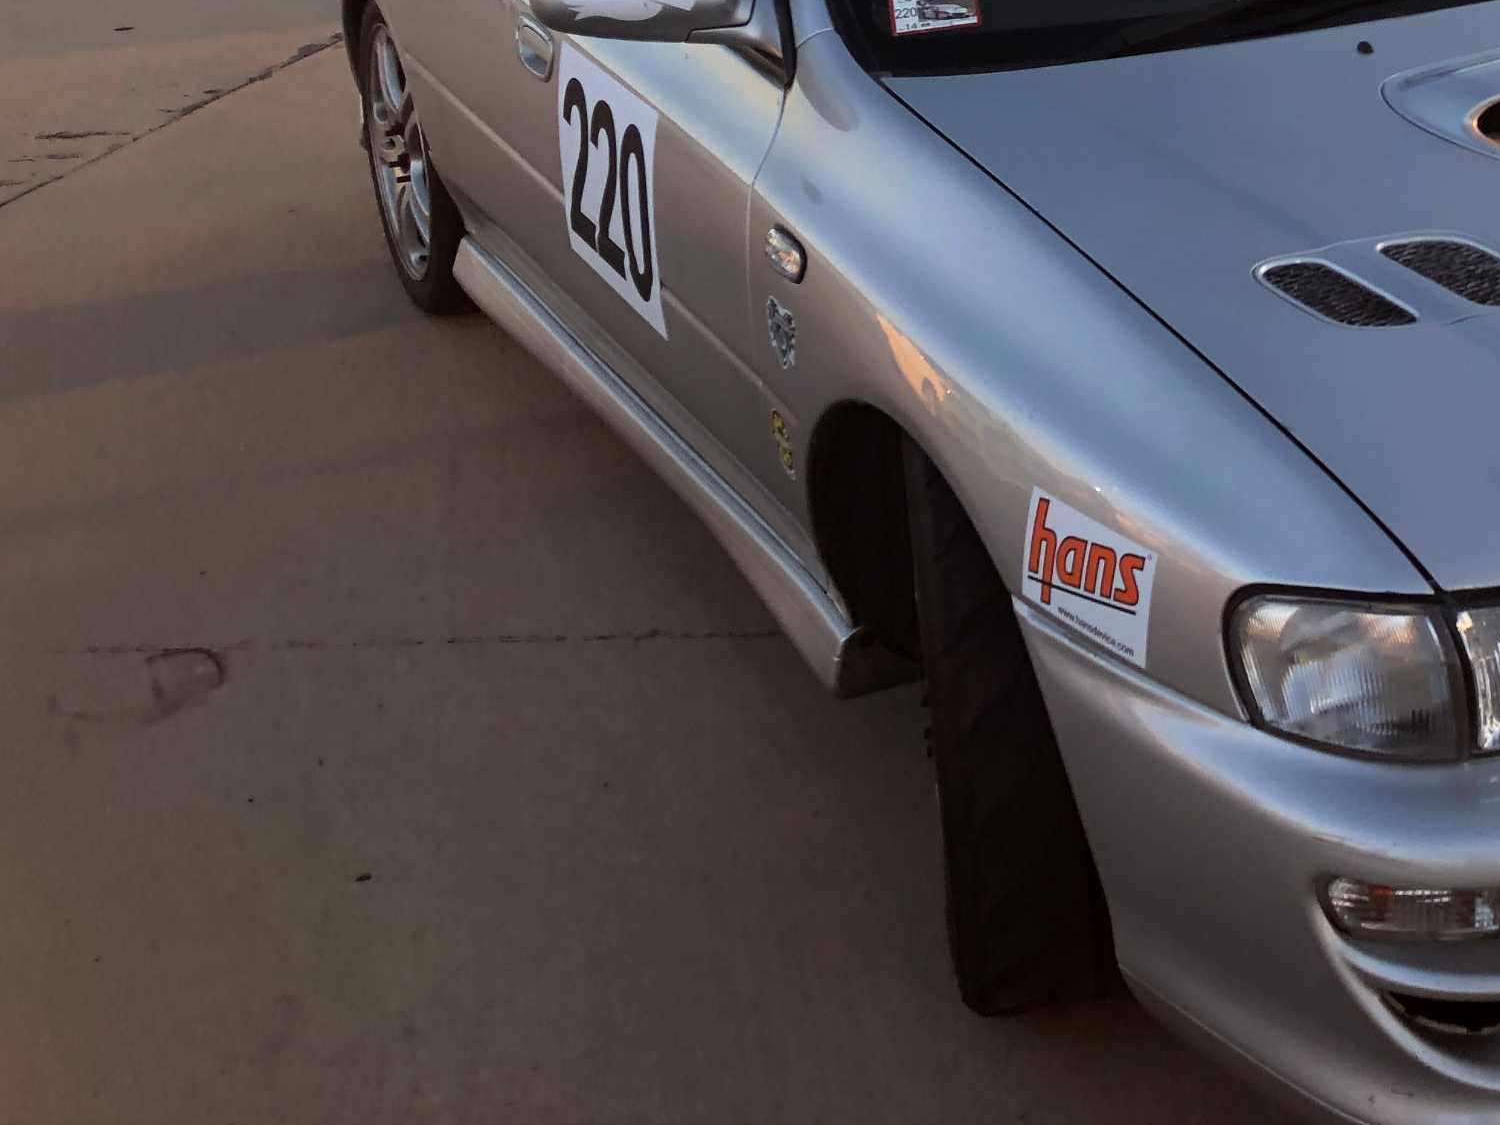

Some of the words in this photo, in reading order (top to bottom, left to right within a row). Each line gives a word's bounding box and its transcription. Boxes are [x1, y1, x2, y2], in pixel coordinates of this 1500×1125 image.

[895, 7, 918, 20] 220
[563, 77, 655, 303] 220
[1028, 497, 1146, 606] hans
